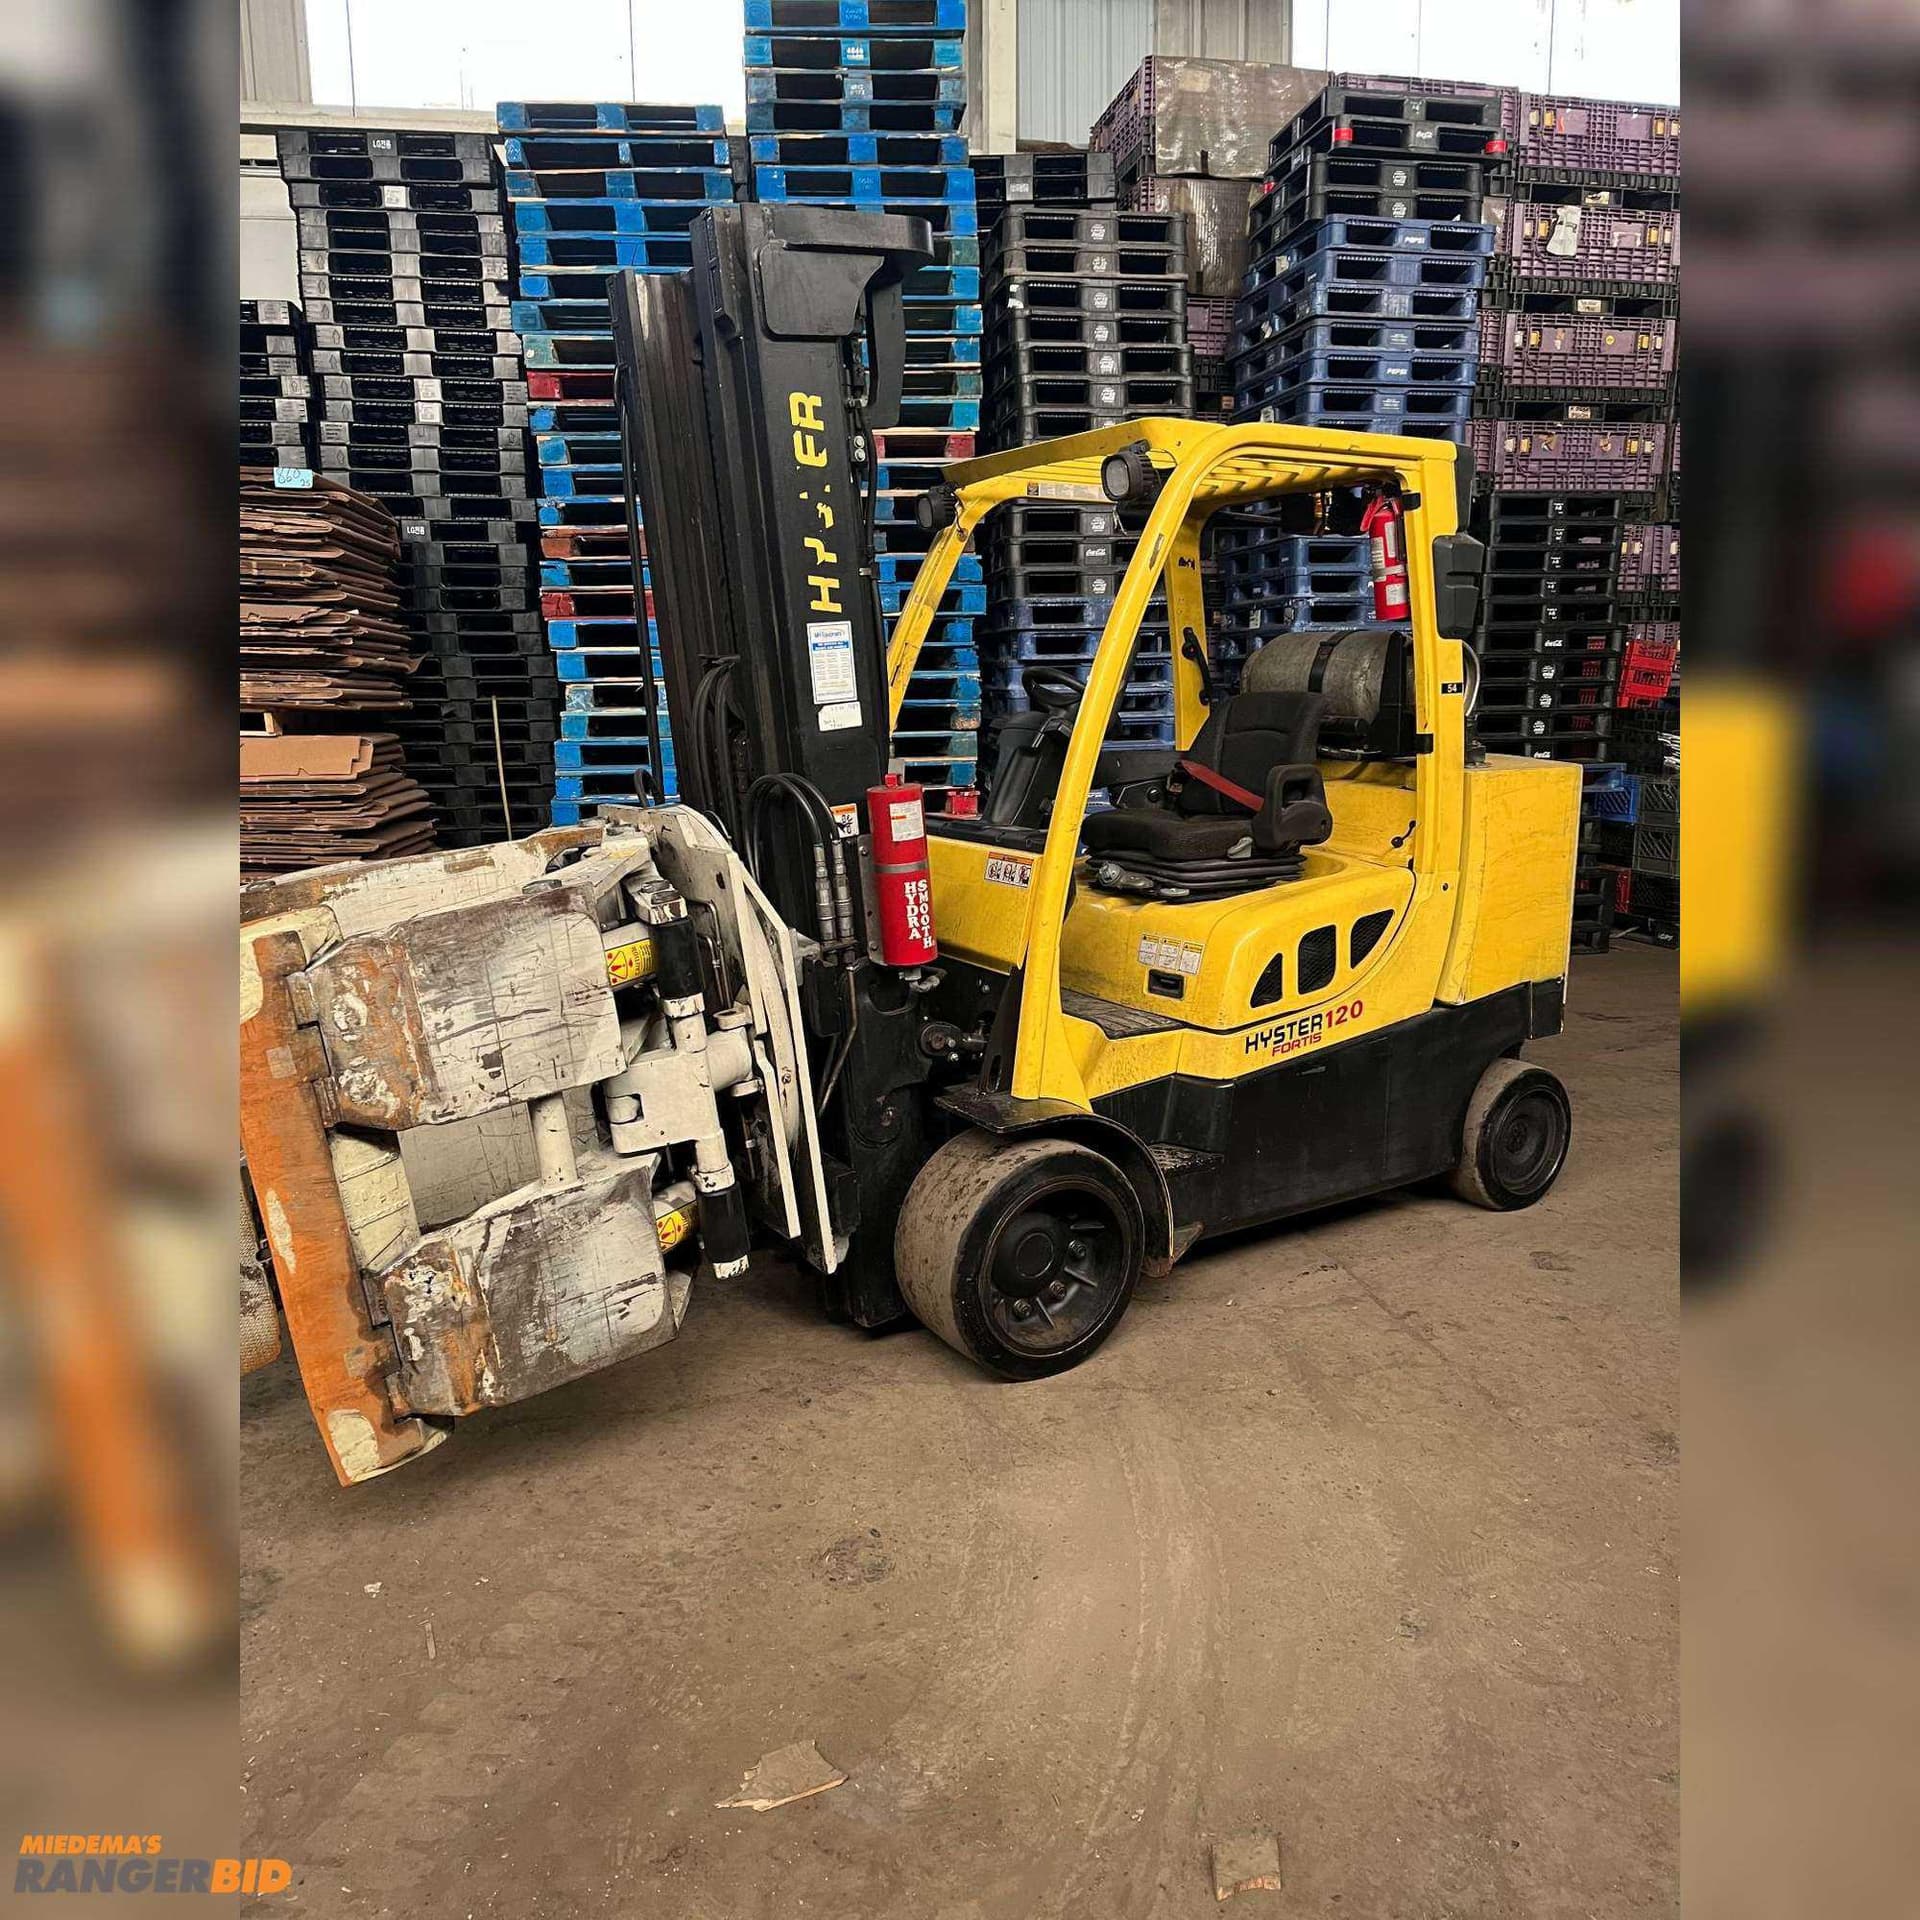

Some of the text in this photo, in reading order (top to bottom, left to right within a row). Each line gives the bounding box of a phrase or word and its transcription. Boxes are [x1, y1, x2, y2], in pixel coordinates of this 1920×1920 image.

[1447, 683, 1457, 693] 54
[904, 881, 922, 941] HYDRA
[917, 878, 933, 949] SMOOTH
[1244, 999, 1364, 1054] HYSTER 120
[1271, 1032, 1322, 1057] FORTIS
